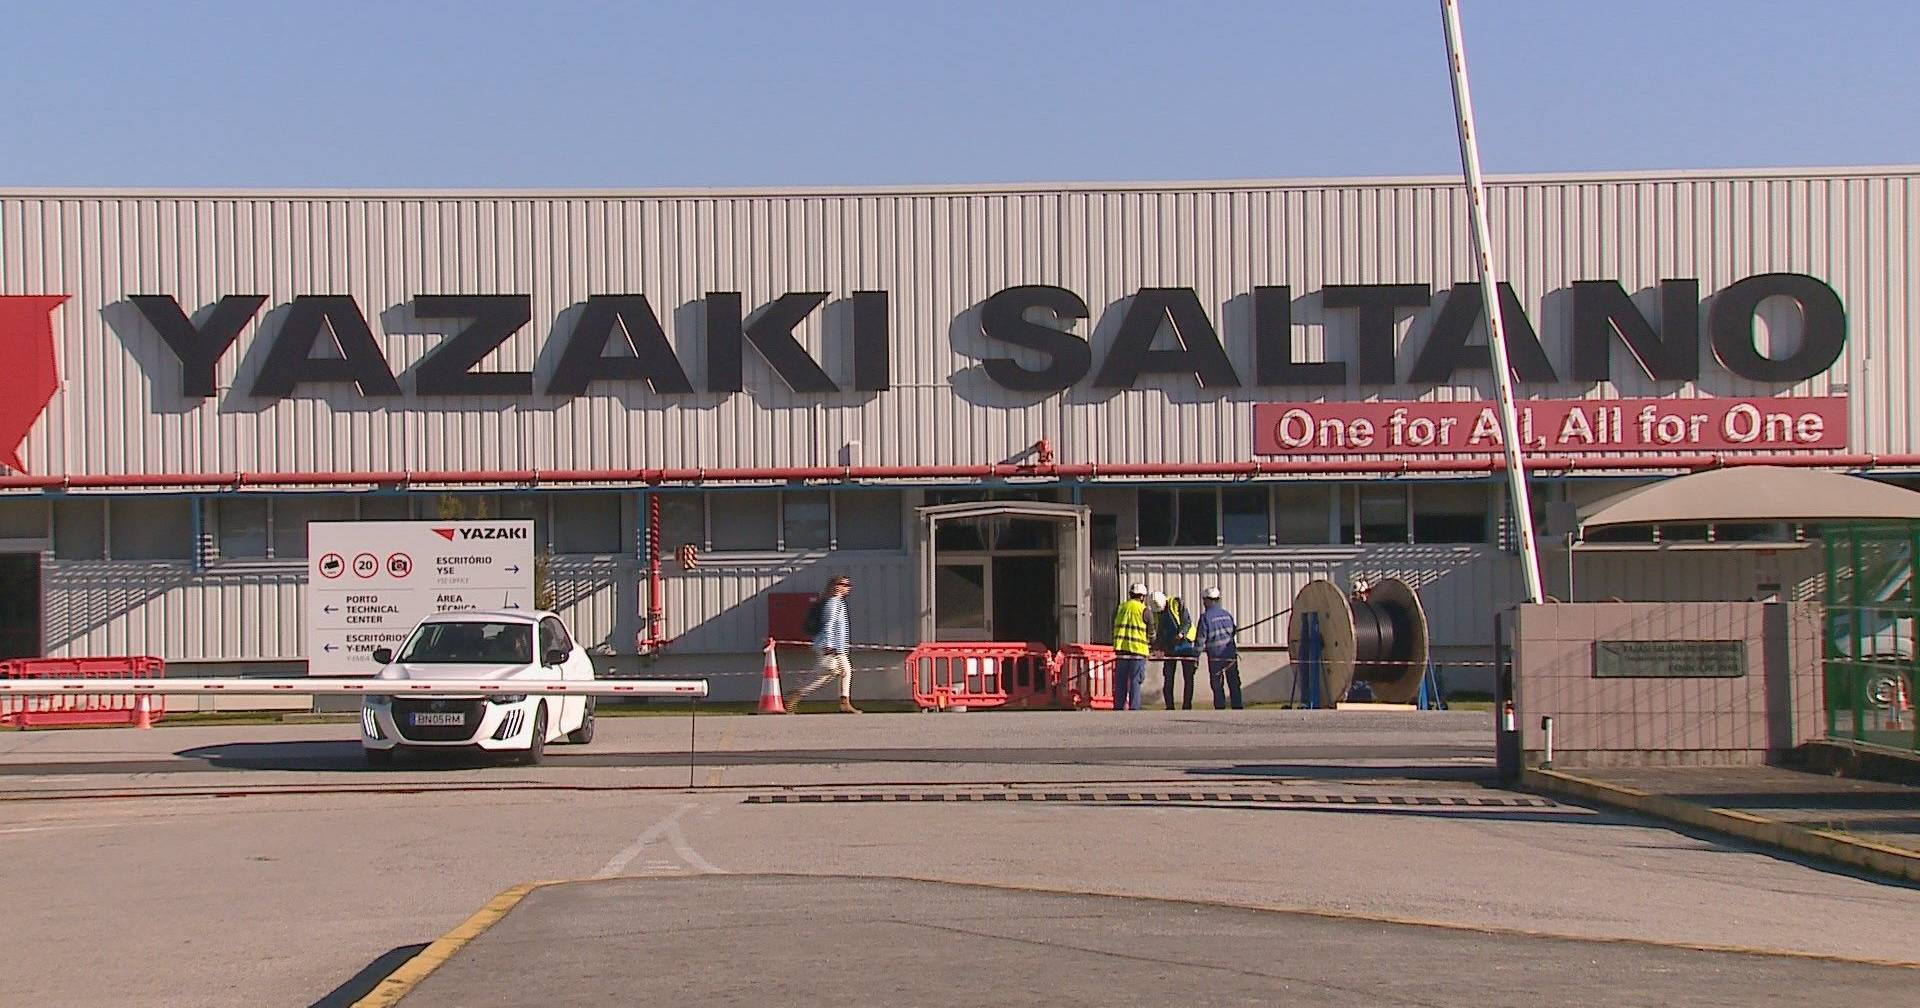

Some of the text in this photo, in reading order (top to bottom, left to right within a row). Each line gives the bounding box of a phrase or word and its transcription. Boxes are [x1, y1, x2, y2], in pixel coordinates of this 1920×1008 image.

[127, 272, 1847, 397] YAZAKI SALTANO
[1279, 403, 1825, 449] One for Al, All for One
[459, 528, 527, 539] YAZAKI
[436, 555, 492, 564] ESCRITÓRIO
[359, 561, 372, 570] 20
[437, 567, 455, 575] YSE
[346, 595, 378, 603] PORTO
[436, 593, 463, 602] ÁREA
[346, 605, 399, 613] TECHNICAL
[346, 615, 383, 623] CENTER
